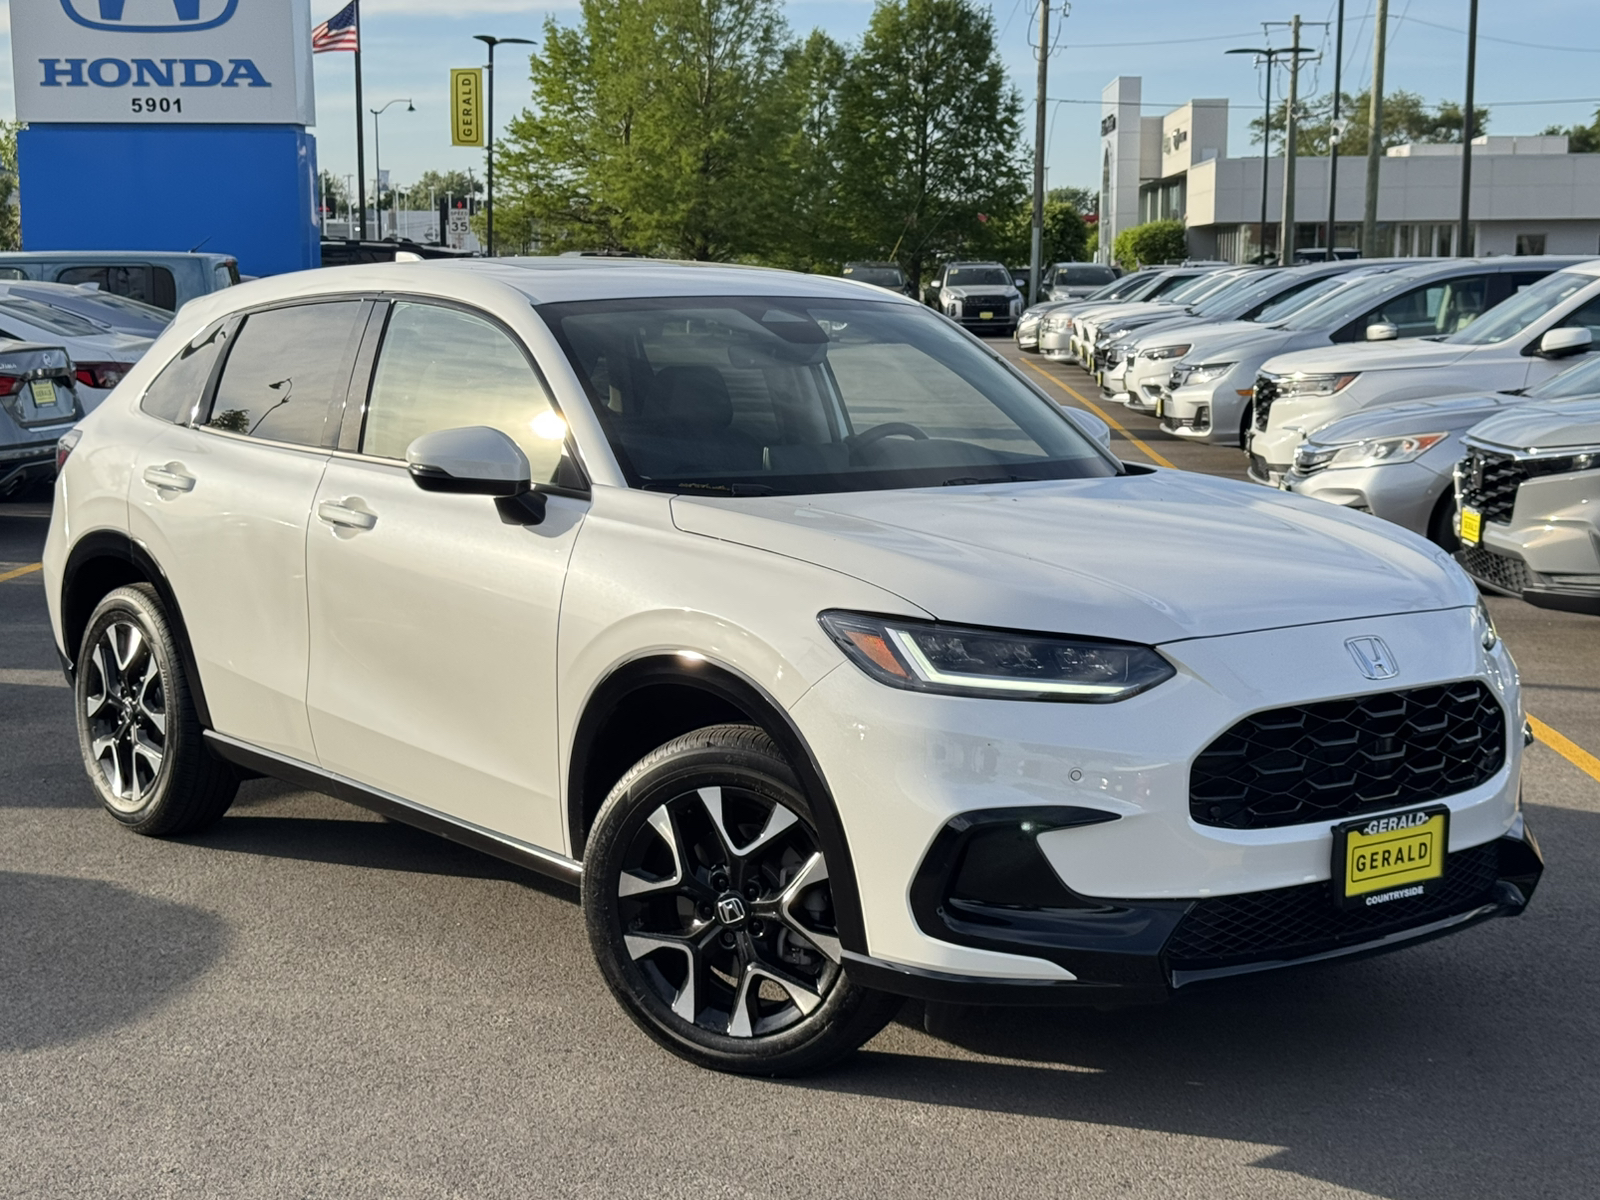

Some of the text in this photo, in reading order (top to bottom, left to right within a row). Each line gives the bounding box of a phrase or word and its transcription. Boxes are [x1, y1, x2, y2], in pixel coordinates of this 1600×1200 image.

[38, 58, 272, 88] HONDA
[131, 97, 182, 113] 5901
[462, 78, 473, 137] GERALD
[451, 222, 468, 232] 35
[1368, 811, 1425, 835] GERALD
[1356, 842, 1428, 872] GERALD
[1365, 885, 1424, 906] COUNTRYSIDE
